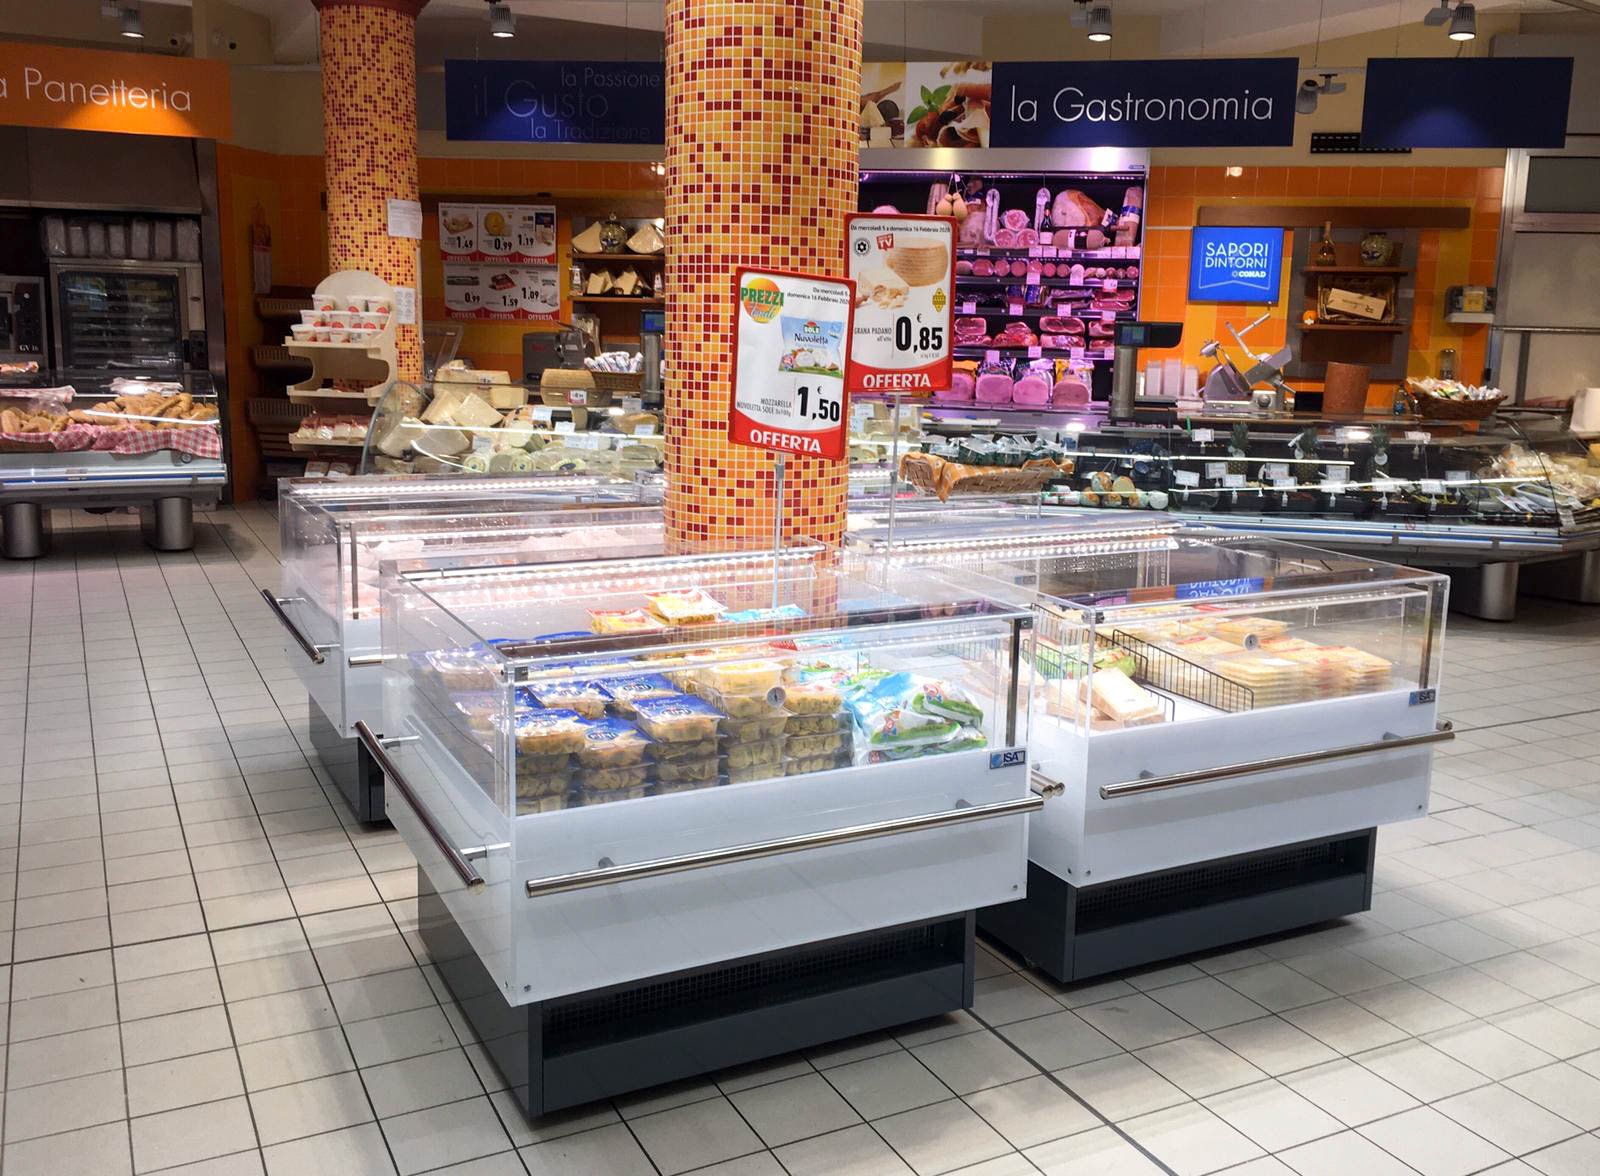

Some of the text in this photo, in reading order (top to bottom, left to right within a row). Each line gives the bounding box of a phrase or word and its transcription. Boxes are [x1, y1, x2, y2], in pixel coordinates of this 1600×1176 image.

[560, 65, 661, 88] la Passione
[24, 67, 191, 112] Panetteria
[473, 76, 609, 119] il Gusto
[1010, 84, 1273, 122] la Gastronomia
[531, 117, 651, 140] la Tradizione
[1205, 242, 1269, 257] SAPORI
[1204, 257, 1267, 269] DINTORNI
[1239, 270, 1267, 278] CONAD
[740, 287, 785, 307] PREZZI
[527, 313, 553, 321] OFFERTA
[794, 333, 829, 345] Nuvoletta
[871, 327, 892, 335] PADANO
[895, 316, 943, 354] 0,85
[862, 373, 931, 389] OFFERTA
[760, 398, 792, 408] MOZZARELLA
[797, 386, 840, 422] 1,50
[749, 429, 822, 454] OFFERTA
[1004, 751, 1019, 763] ISA
